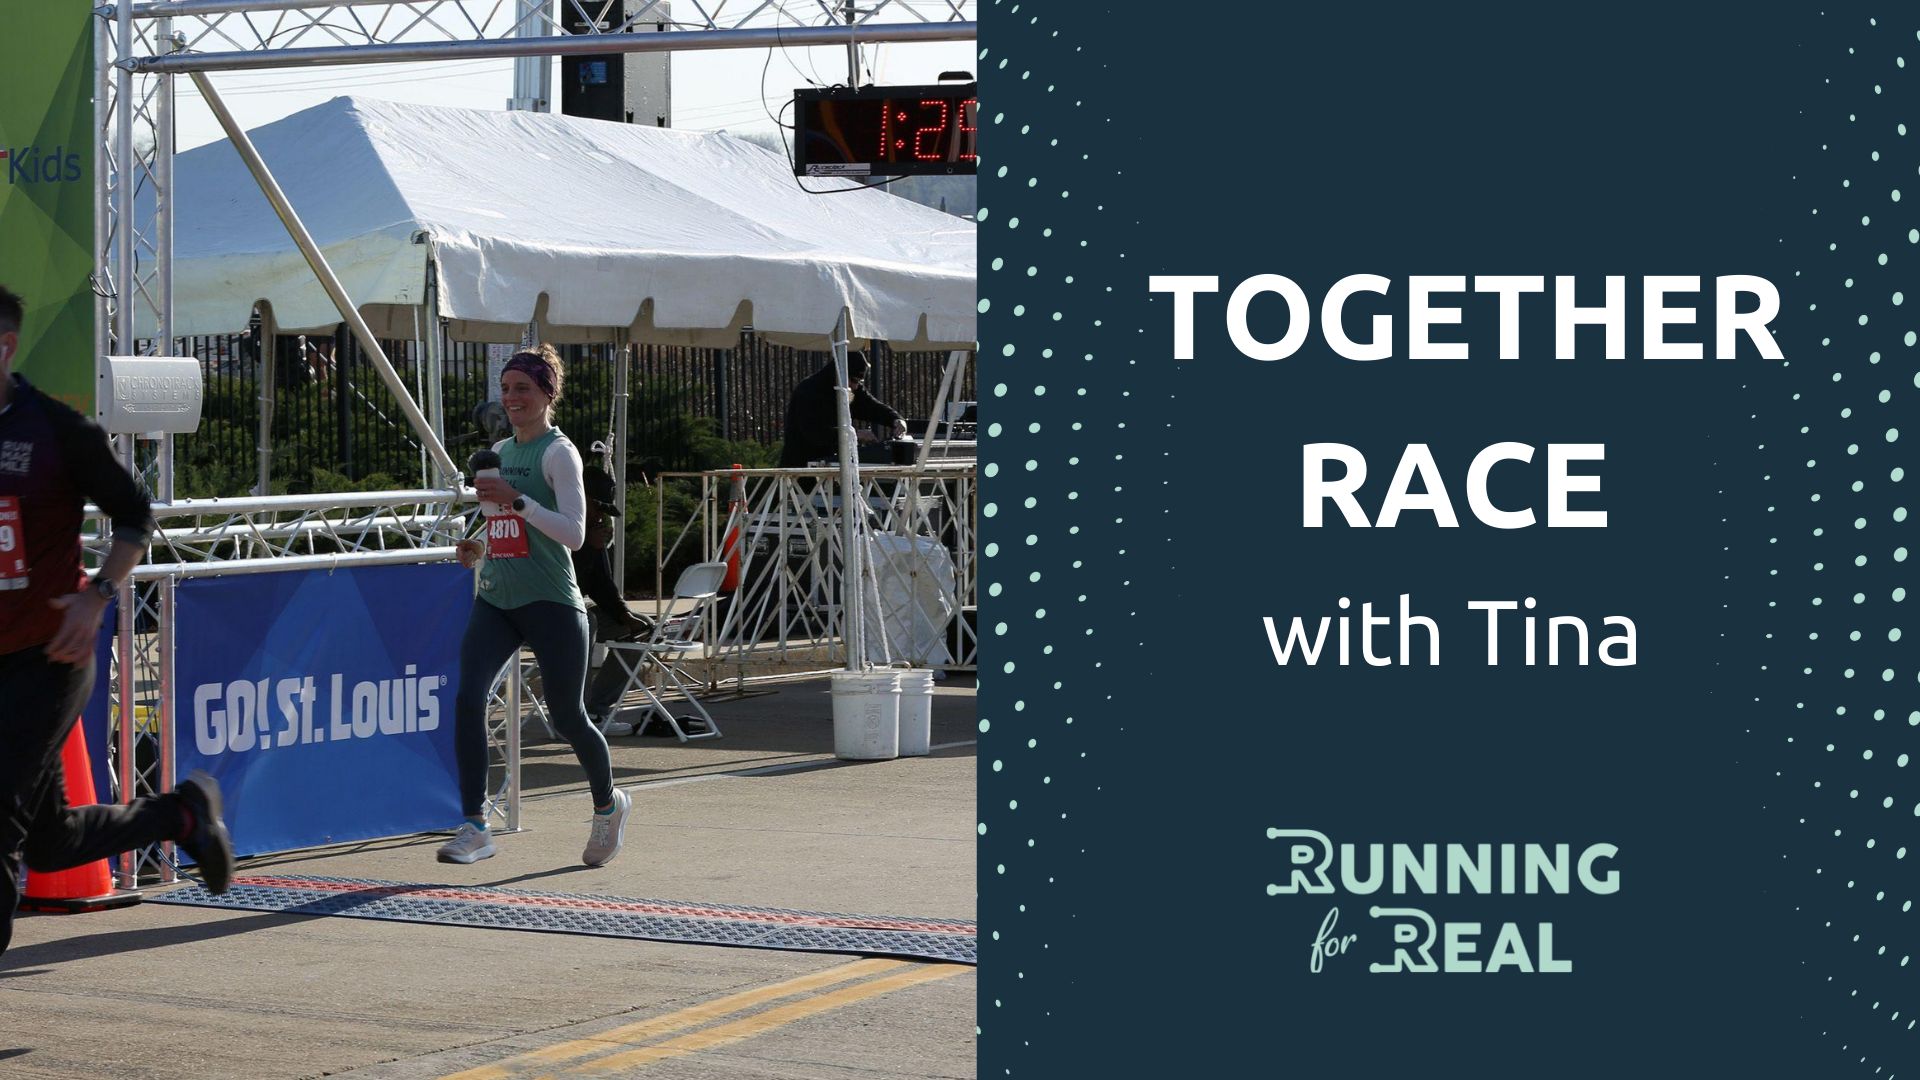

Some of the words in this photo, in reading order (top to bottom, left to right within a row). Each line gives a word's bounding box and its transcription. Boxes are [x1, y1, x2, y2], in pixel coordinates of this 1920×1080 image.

[9, 146, 82, 184] Kids
[130, 376, 200, 389] CHRONOTRACK
[131, 390, 200, 400] SYSTEMS
[489, 518, 520, 539] 4870
[193, 676, 270, 756] GO!
[276, 676, 324, 747] St.
